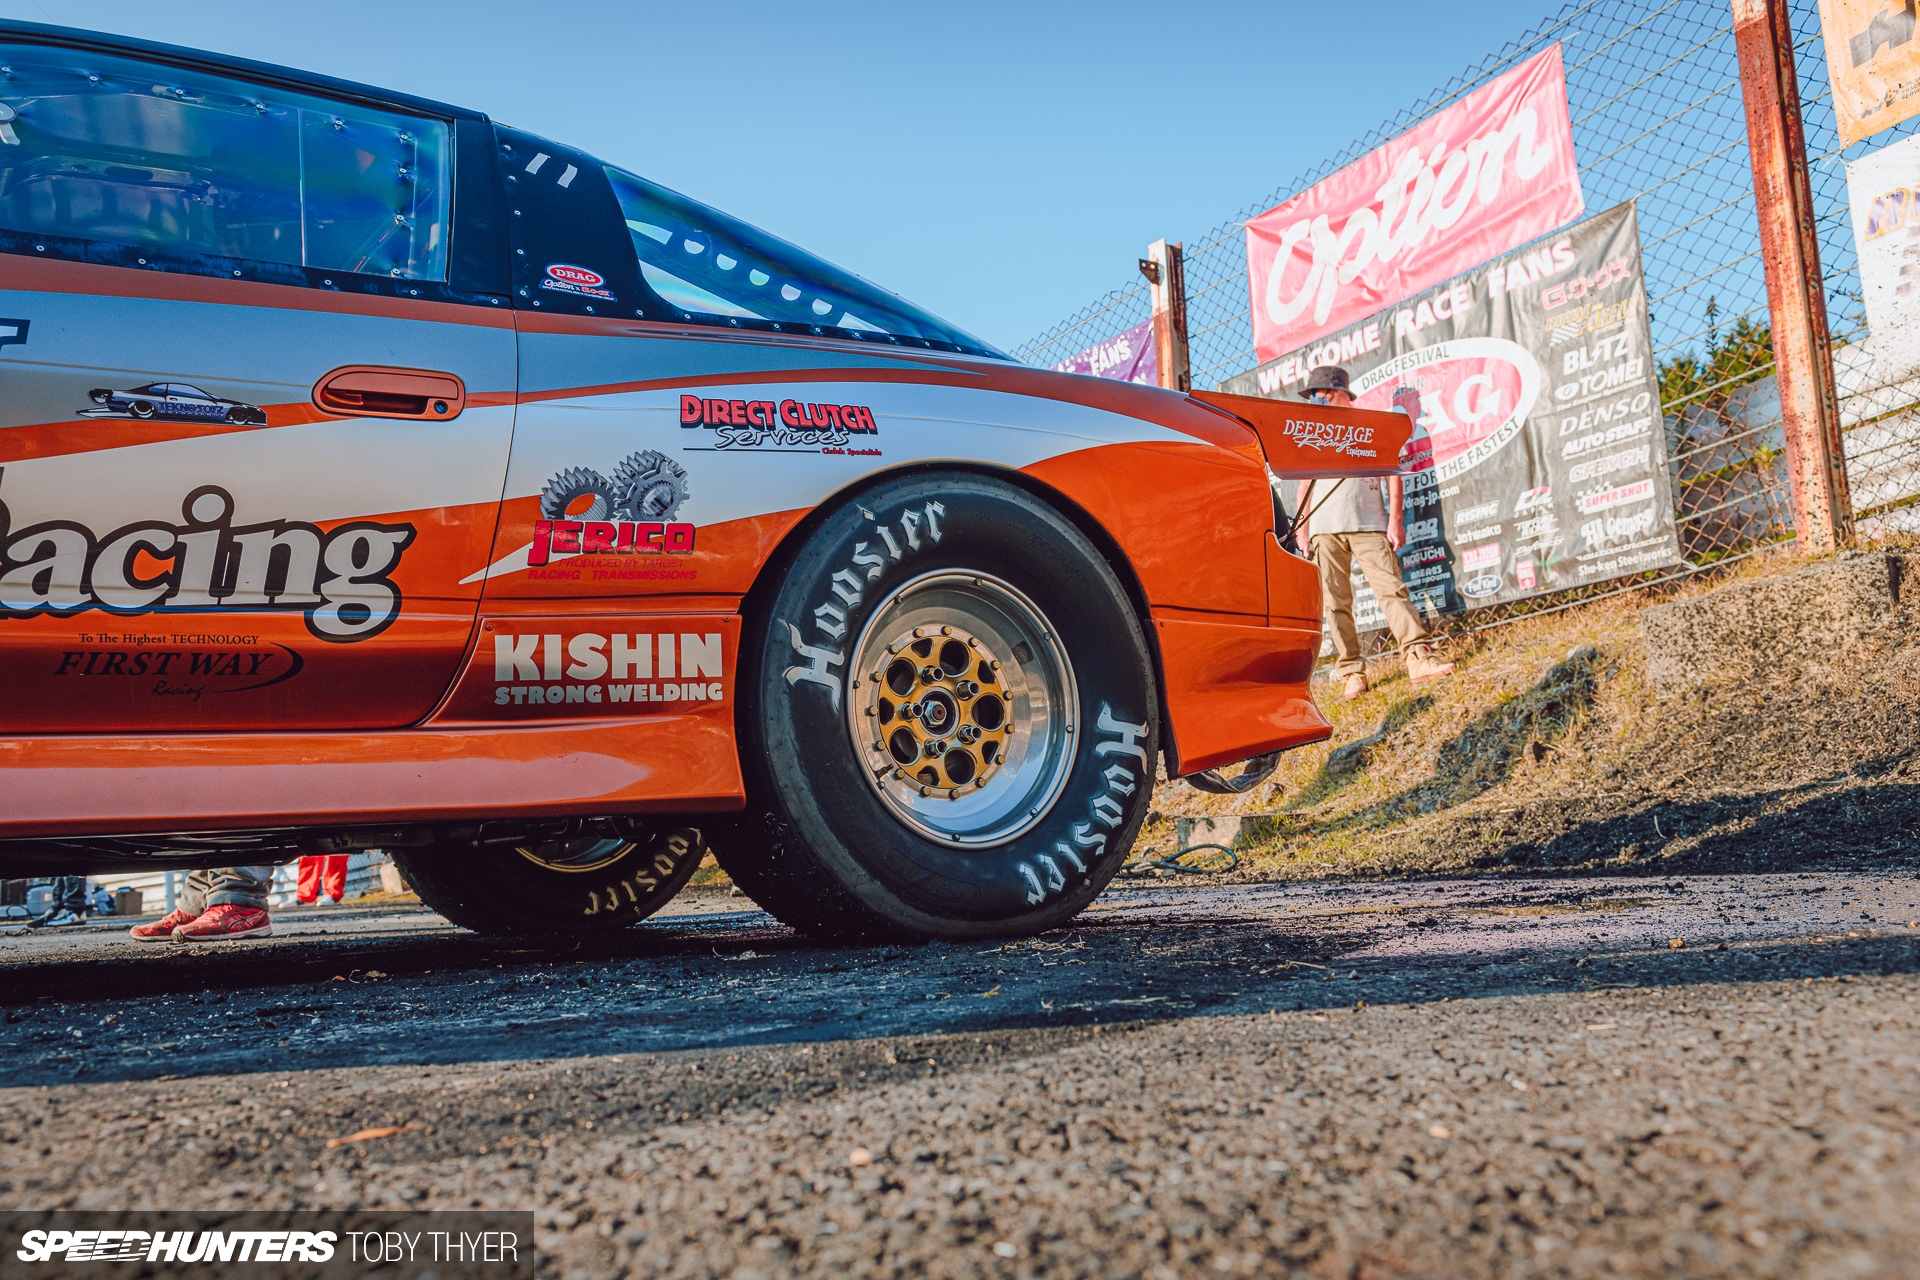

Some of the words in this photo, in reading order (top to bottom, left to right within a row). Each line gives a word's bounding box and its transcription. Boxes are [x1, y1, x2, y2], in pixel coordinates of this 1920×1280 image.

[1265, 108, 1552, 326] Option
[544, 279, 574, 291] Option
[555, 268, 596, 283] DRAG
[1258, 322, 1382, 394] WELCOME
[1394, 282, 1471, 340] RACE
[1487, 238, 1576, 299] FANS
[1545, 303, 1592, 332] ROYAL
[1577, 295, 1640, 336] PURPLE
[1563, 330, 1629, 376] BLITZ
[1391, 377, 1425, 400] JAPAN
[1580, 357, 1644, 396] TOMEI
[680, 394, 777, 430] DIRECT
[780, 399, 878, 435] CLUTCH
[1559, 391, 1651, 437] DENSO
[715, 426, 850, 450] Services
[1283, 419, 1375, 443] DEEPSTAGE
[1292, 436, 1357, 452] Racing
[822, 447, 845, 455] Clutch
[847, 448, 883, 457] Specialists
[1346, 446, 1377, 458] Equipments
[1414, 470, 1438, 491] FOR
[1440, 457, 1467, 478] THE
[1468, 416, 1519, 464] FASTEST
[1585, 491, 1618, 508] SUPER
[1620, 482, 1649, 499] SHOT
[1456, 503, 1498, 525] RISING
[527, 520, 696, 566] JERICO
[1403, 546, 1446, 566] NOGUCHI
[0, 485, 417, 643] acing
[528, 570, 580, 580] RACING
[592, 570, 697, 580] TRANSMISSIONS
[559, 558, 622, 568] PRODUCED
[624, 558, 639, 568] BY
[642, 558, 684, 568] TARGET
[1578, 557, 1617, 577] Shu-ken
[1617, 547, 1673, 569] Steelworks
[781, 500, 945, 714] Hoosier
[79, 633, 94, 644] To
[97, 633, 118, 644] The
[123, 633, 167, 646] Highest
[171, 634, 260, 645] TECHNOLOGY
[54, 652, 181, 676] FIRST
[189, 653, 275, 677] WAY
[494, 633, 723, 681] KISHIN
[151, 680, 205, 701] Racing
[495, 685, 602, 705] STRONG
[607, 683, 723, 703] WELDING
[1019, 700, 1149, 906] Hoosier
[583, 827, 701, 915] oosier
